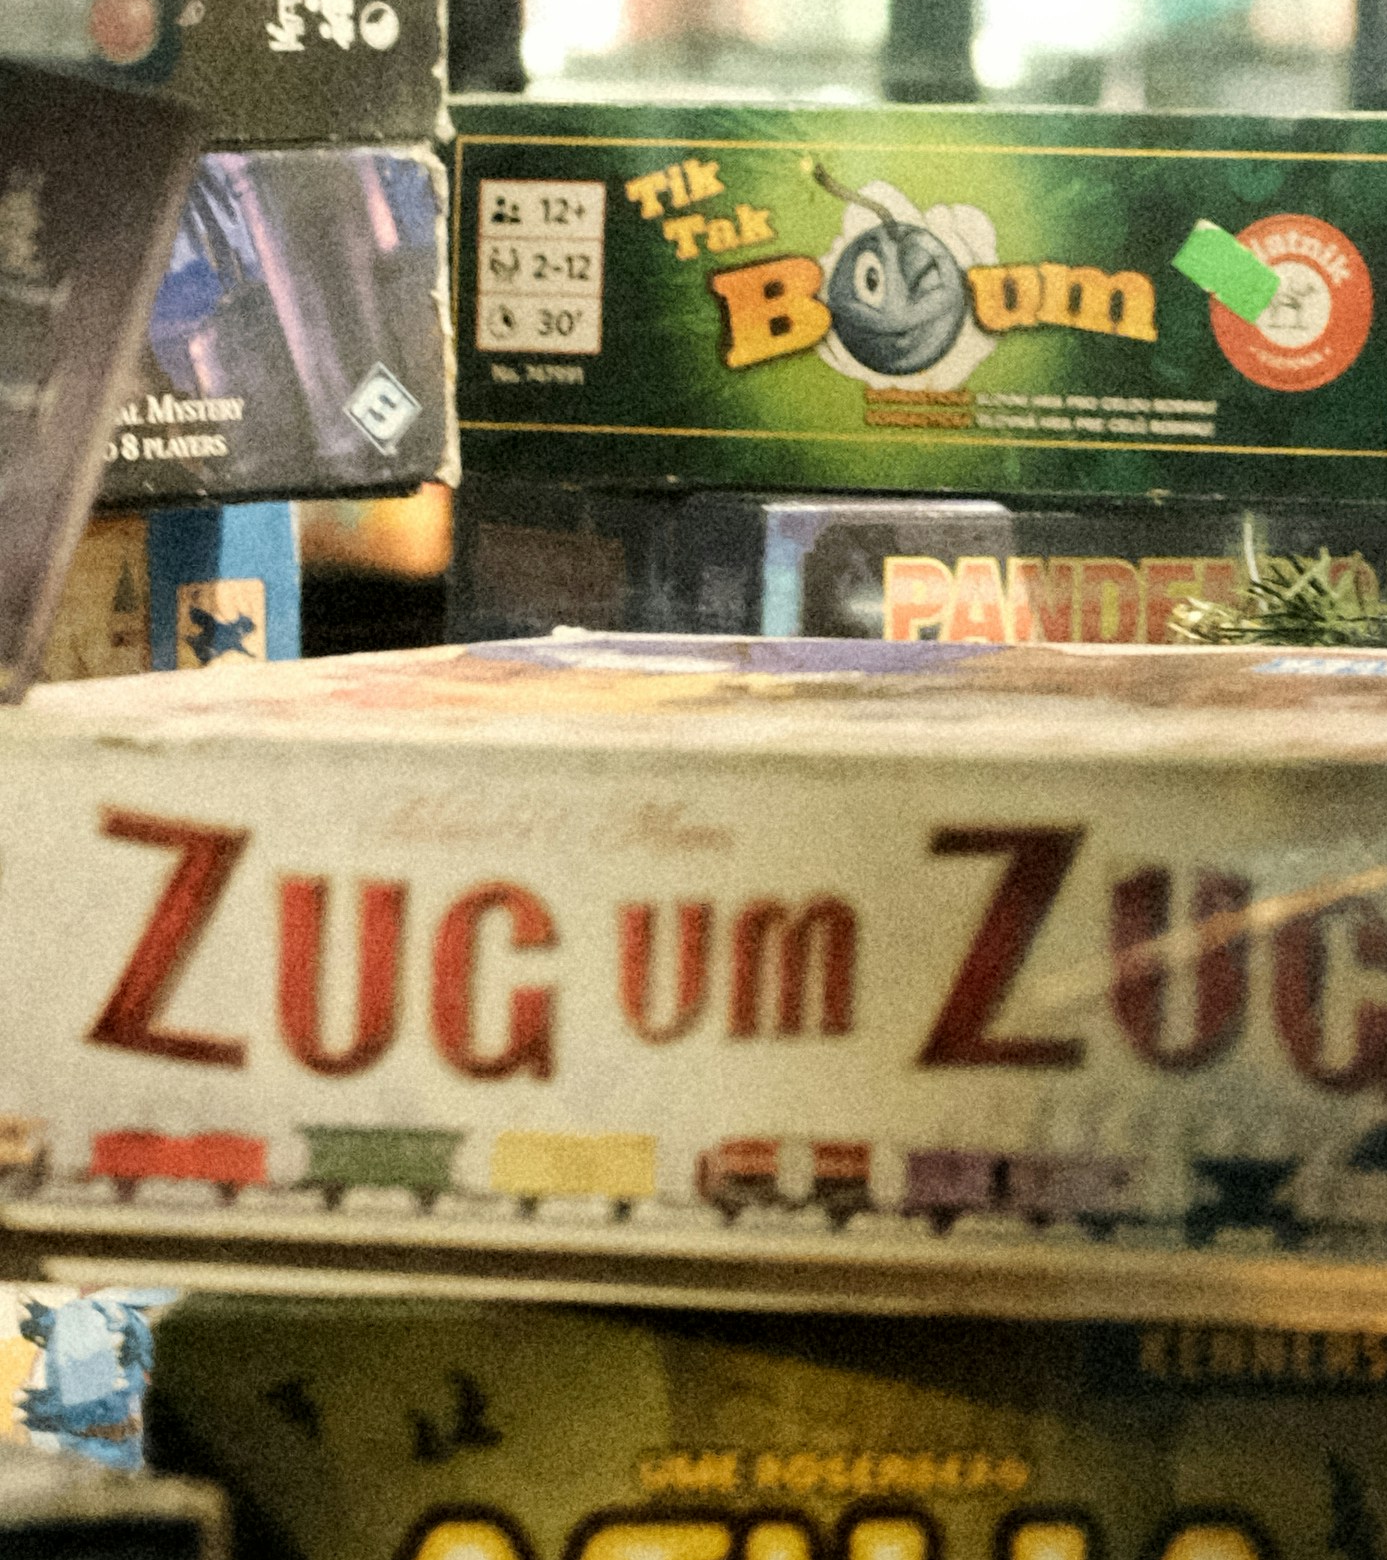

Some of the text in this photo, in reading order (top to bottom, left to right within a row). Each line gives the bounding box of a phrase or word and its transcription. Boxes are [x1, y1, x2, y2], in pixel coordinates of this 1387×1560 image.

[625, 157, 725, 220] Tik
[542, 197, 586, 225] 12+
[661, 204, 778, 262] Tak
[532, 253, 592, 282] 2-12
